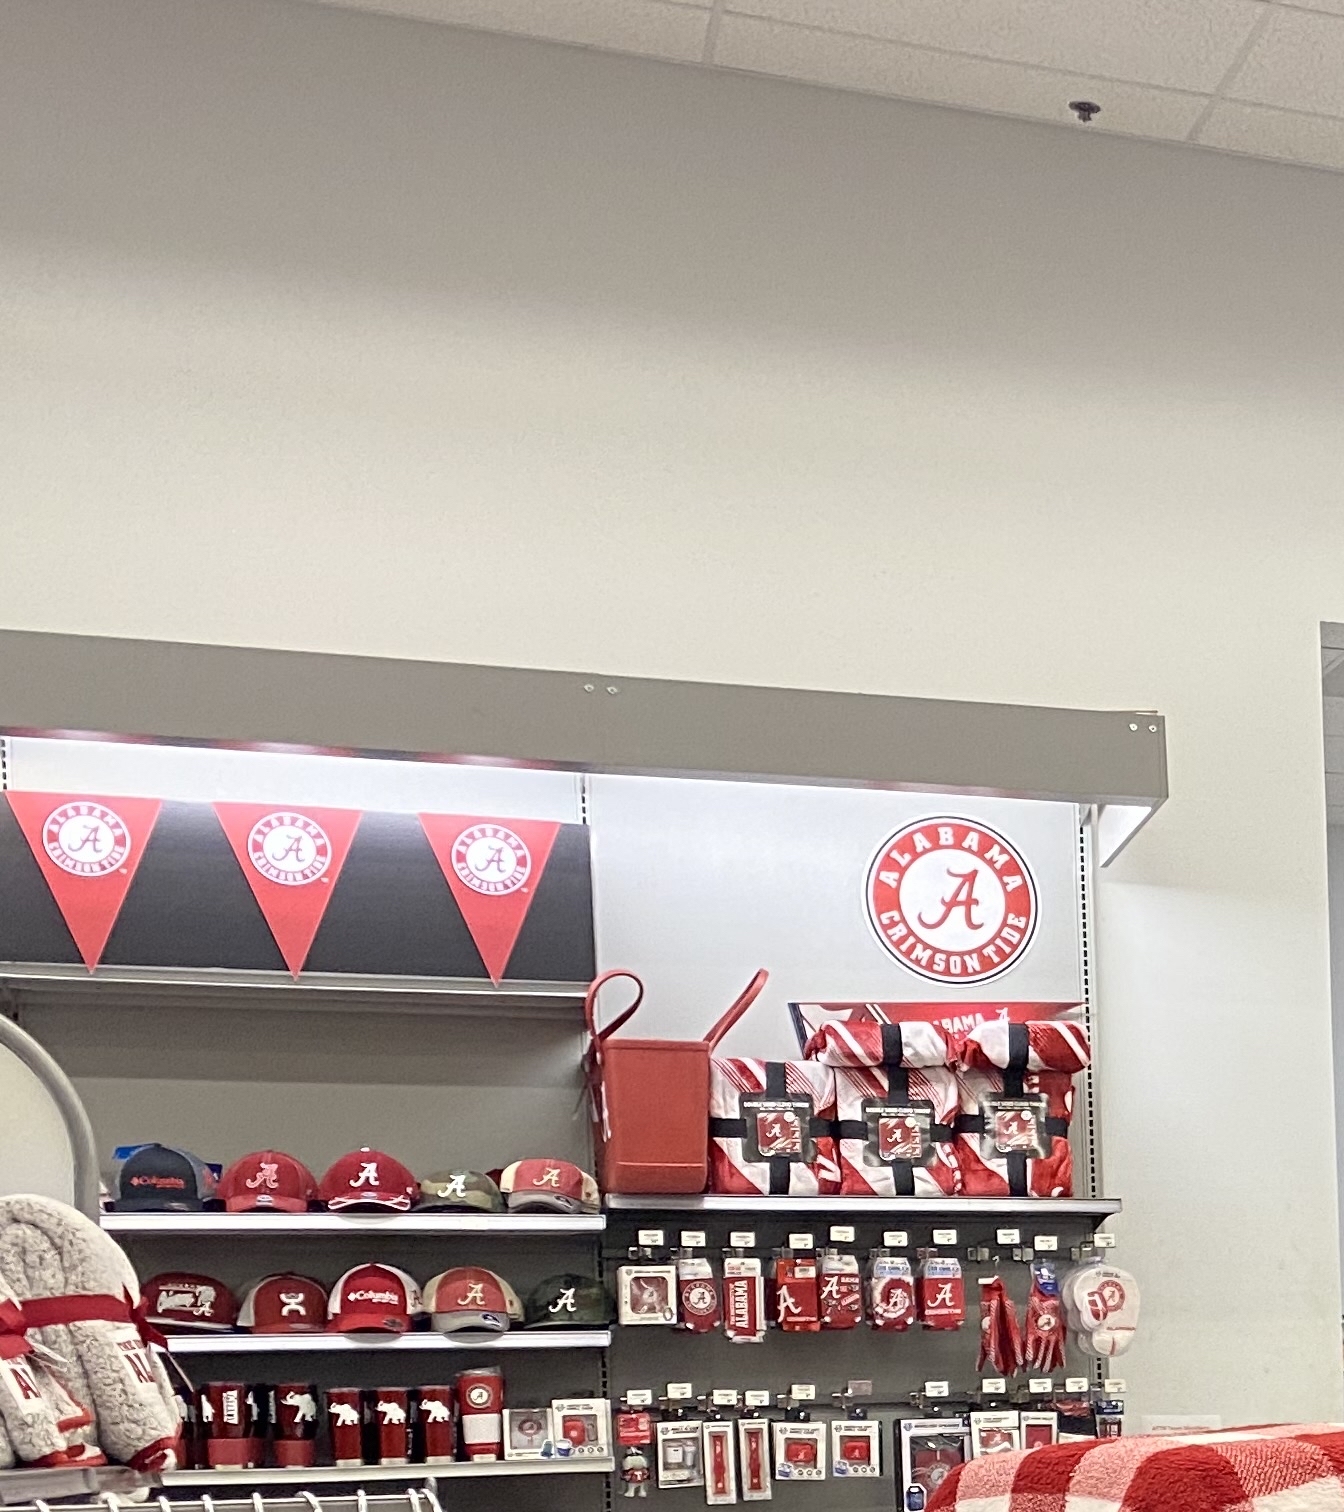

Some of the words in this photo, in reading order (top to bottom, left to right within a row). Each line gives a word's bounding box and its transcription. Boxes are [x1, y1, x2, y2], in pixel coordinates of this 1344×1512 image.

[878, 826, 1023, 893] ALABAMA
[880, 910, 981, 974] CRIMSON
[983, 912, 1027, 964] TIDE
[355, 1289, 399, 1304] Columbia
[735, 1280, 748, 1329] ALABAMA
